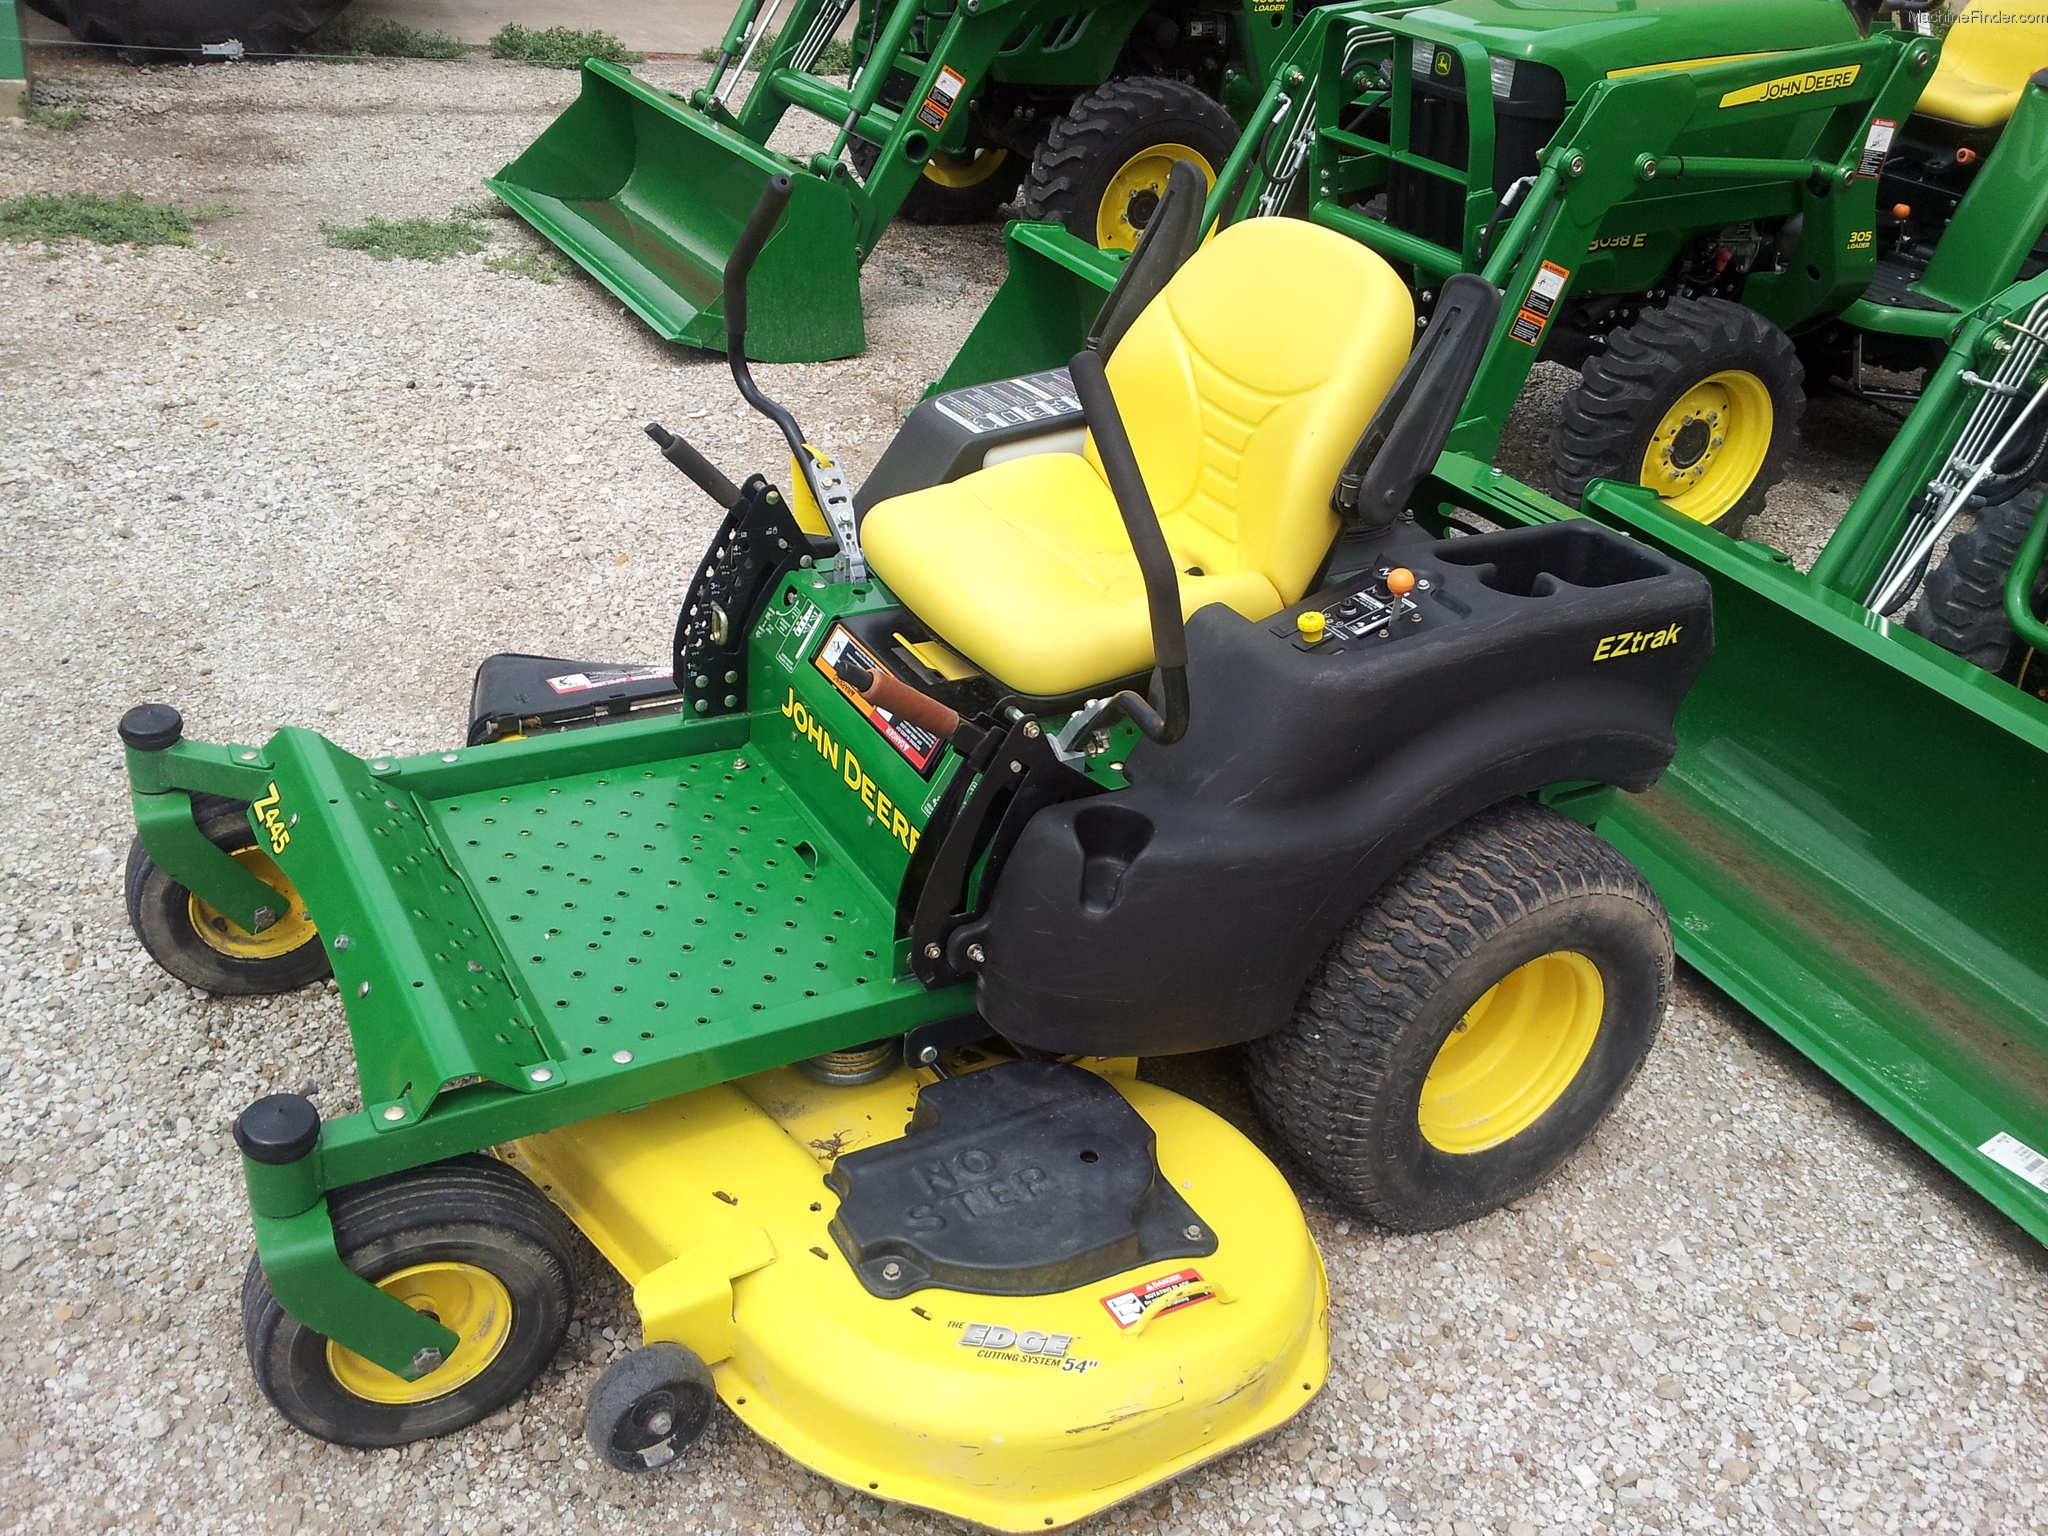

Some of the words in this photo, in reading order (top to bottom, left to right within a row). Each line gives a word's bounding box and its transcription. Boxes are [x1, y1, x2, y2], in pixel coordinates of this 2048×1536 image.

[1253, 4, 1286, 12] LOADER
[1759, 79, 1802, 100] JOHN
[1804, 71, 1853, 91] DEERE
[1847, 242, 1871, 250] LOADER
[1849, 231, 1873, 242] 305
[1592, 622, 1684, 662] EZtrak
[781, 687, 839, 771] JOHN
[884, 725, 907, 748] DANGER
[253, 781, 291, 855] Z445
[911, 1149, 998, 1197] NO
[902, 1166, 1047, 1234] STEP
[1151, 1273, 1182, 1288] DANGER
[947, 1320, 966, 1329] THE
[960, 1322, 1073, 1357] EDGE
[976, 1349, 1020, 1362] CUTTING
[1020, 1354, 1062, 1367] SYSTEM
[1061, 1357, 1099, 1374] 54"
